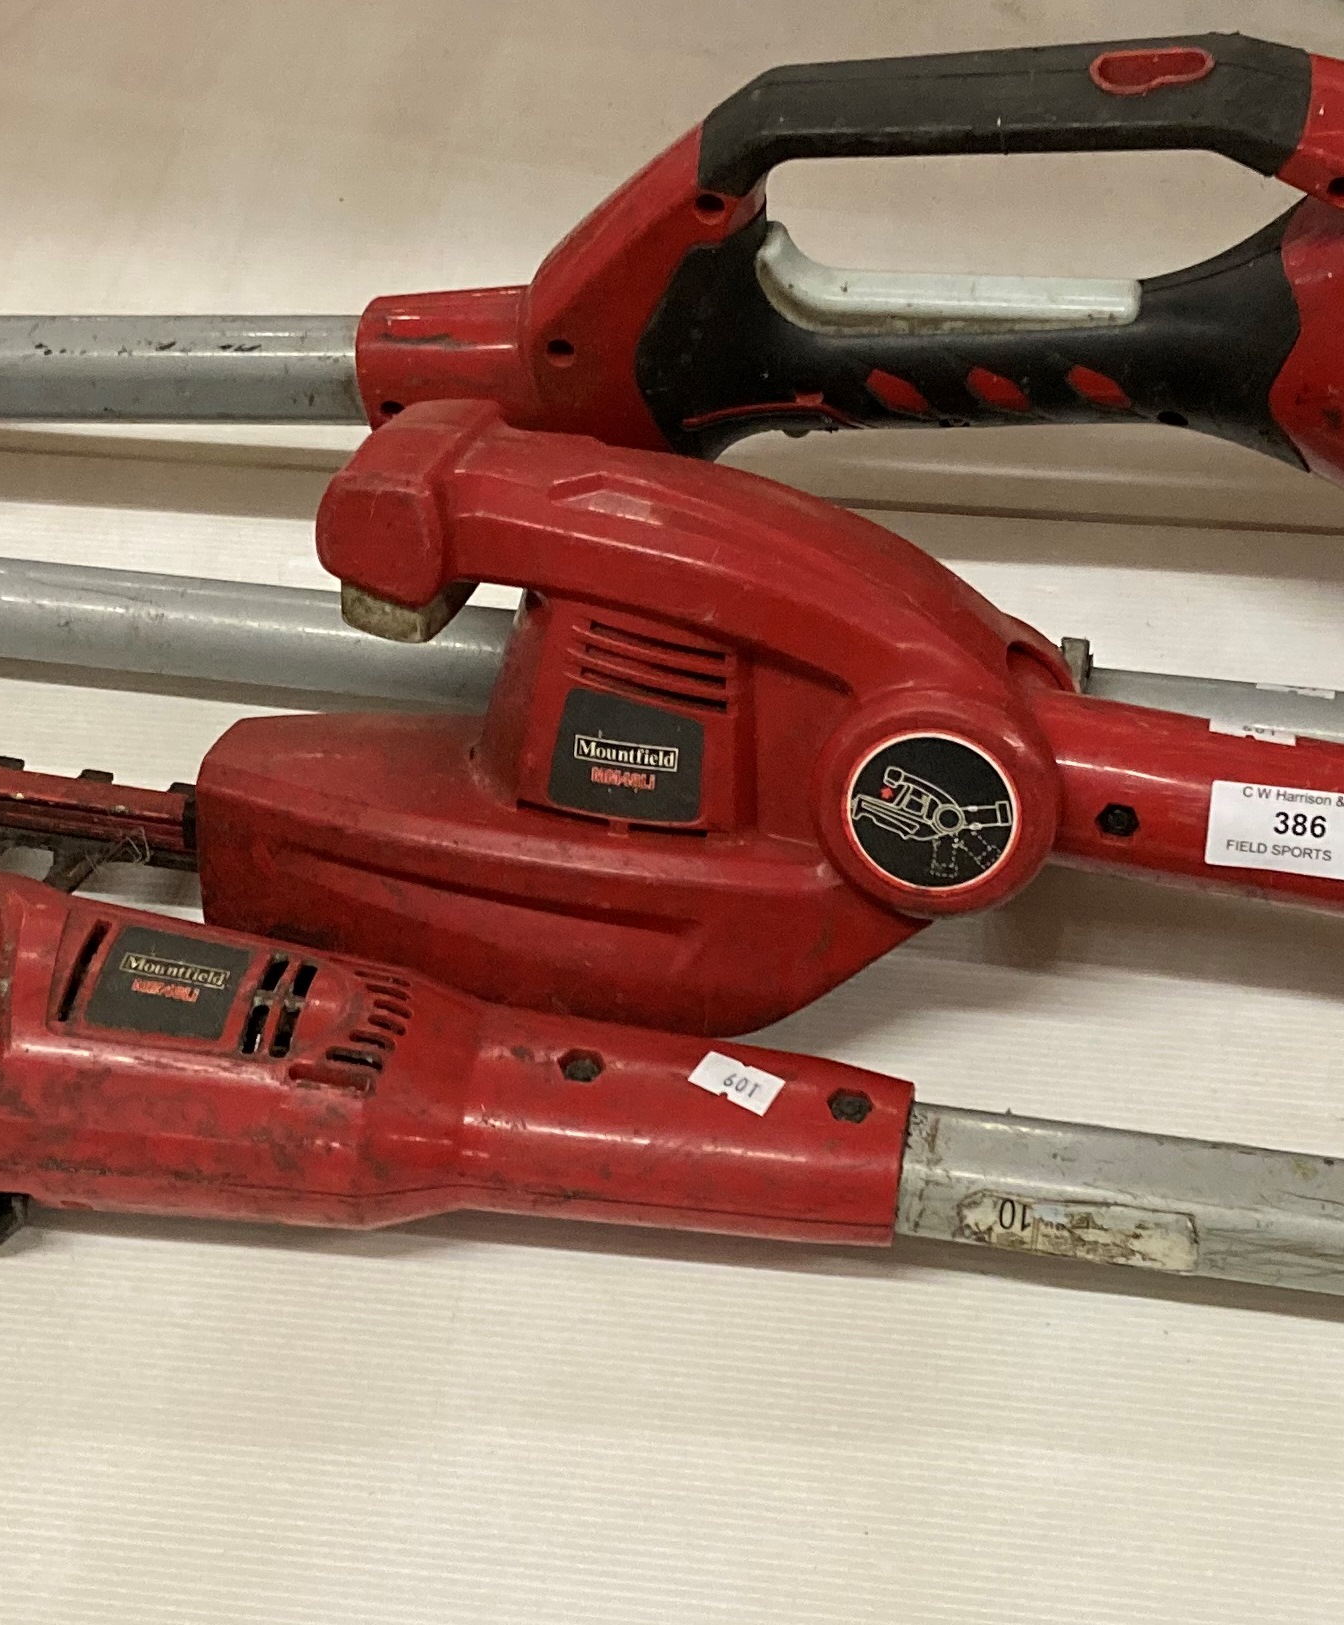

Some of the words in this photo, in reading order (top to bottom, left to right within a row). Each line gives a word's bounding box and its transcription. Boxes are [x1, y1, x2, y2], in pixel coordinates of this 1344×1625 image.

[579, 739, 675, 767] Mountfield
[1242, 786, 1254, 798] C
[1257, 787, 1272, 799] W
[1276, 789, 1332, 807] Harrison
[1335, 795, 1344, 807] &
[1274, 811, 1327, 838] 386
[1225, 839, 1268, 854] FIELD
[1271, 844, 1332, 862] SPORTS
[126, 956, 226, 986] Mountfield
[998, 1198, 1032, 1232] 10
